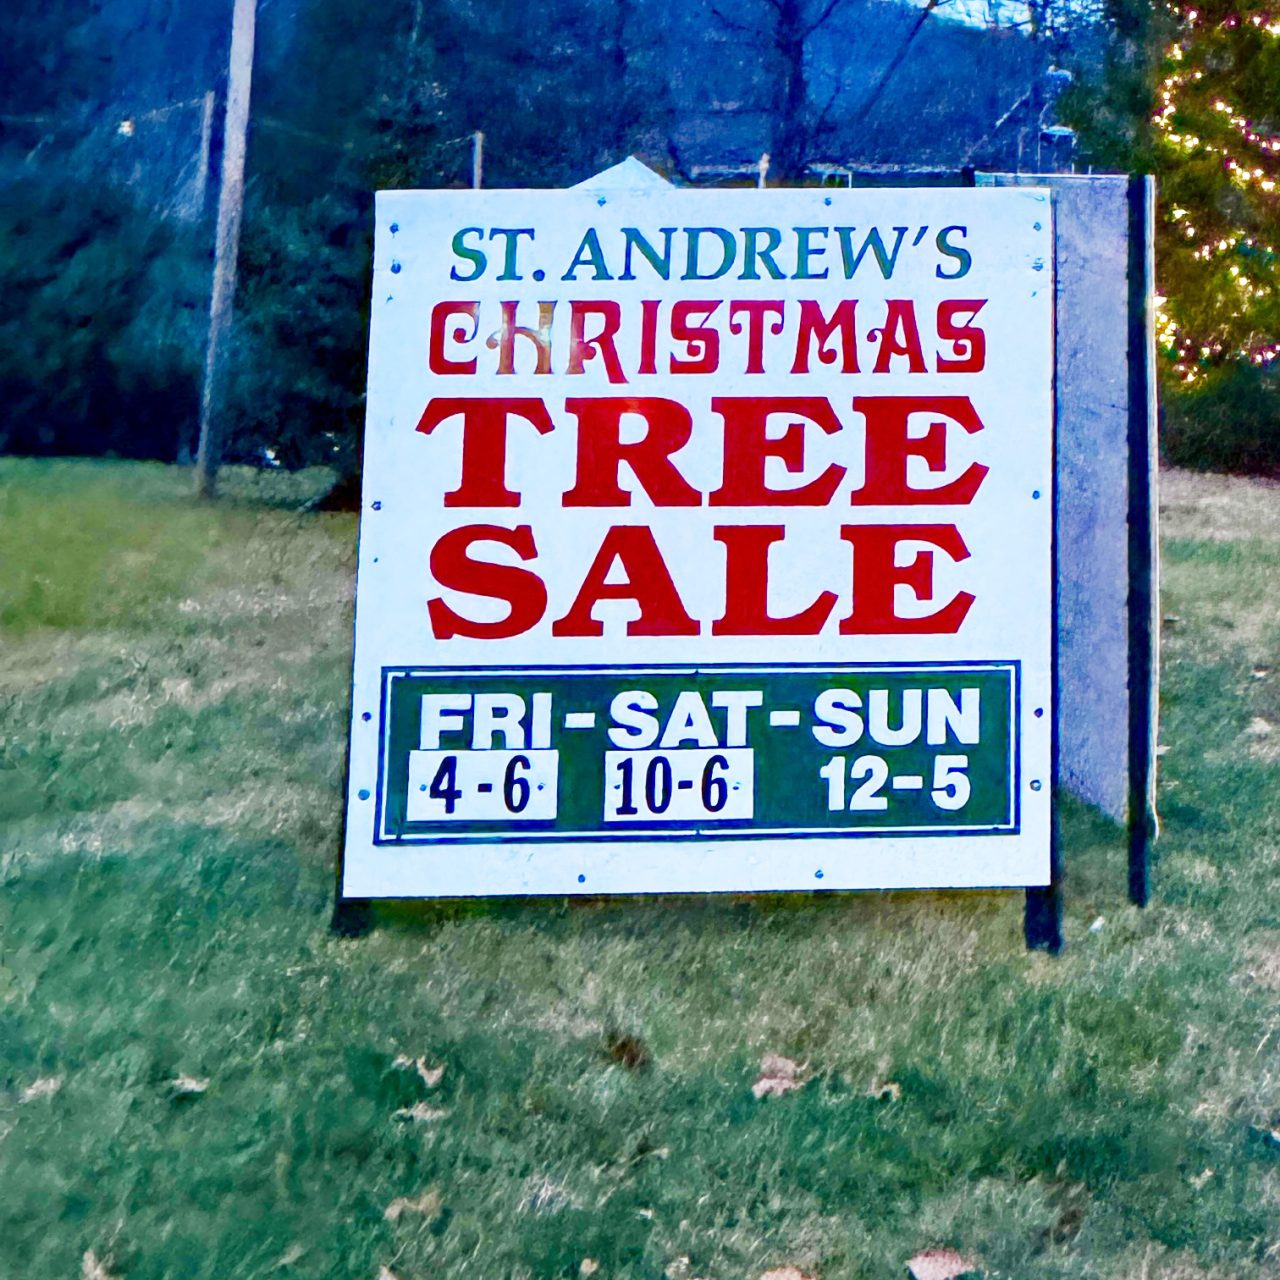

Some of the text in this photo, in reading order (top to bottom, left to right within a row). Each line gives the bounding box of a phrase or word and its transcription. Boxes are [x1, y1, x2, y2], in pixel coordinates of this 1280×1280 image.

[450, 225, 973, 282] ST. ANDREW'S
[428, 298, 989, 384] CHRISTMAS
[415, 395, 990, 509] TREE
[426, 523, 977, 641] SALE
[614, 754, 730, 816] 10-6
[819, 753, 971, 812] 12-5
